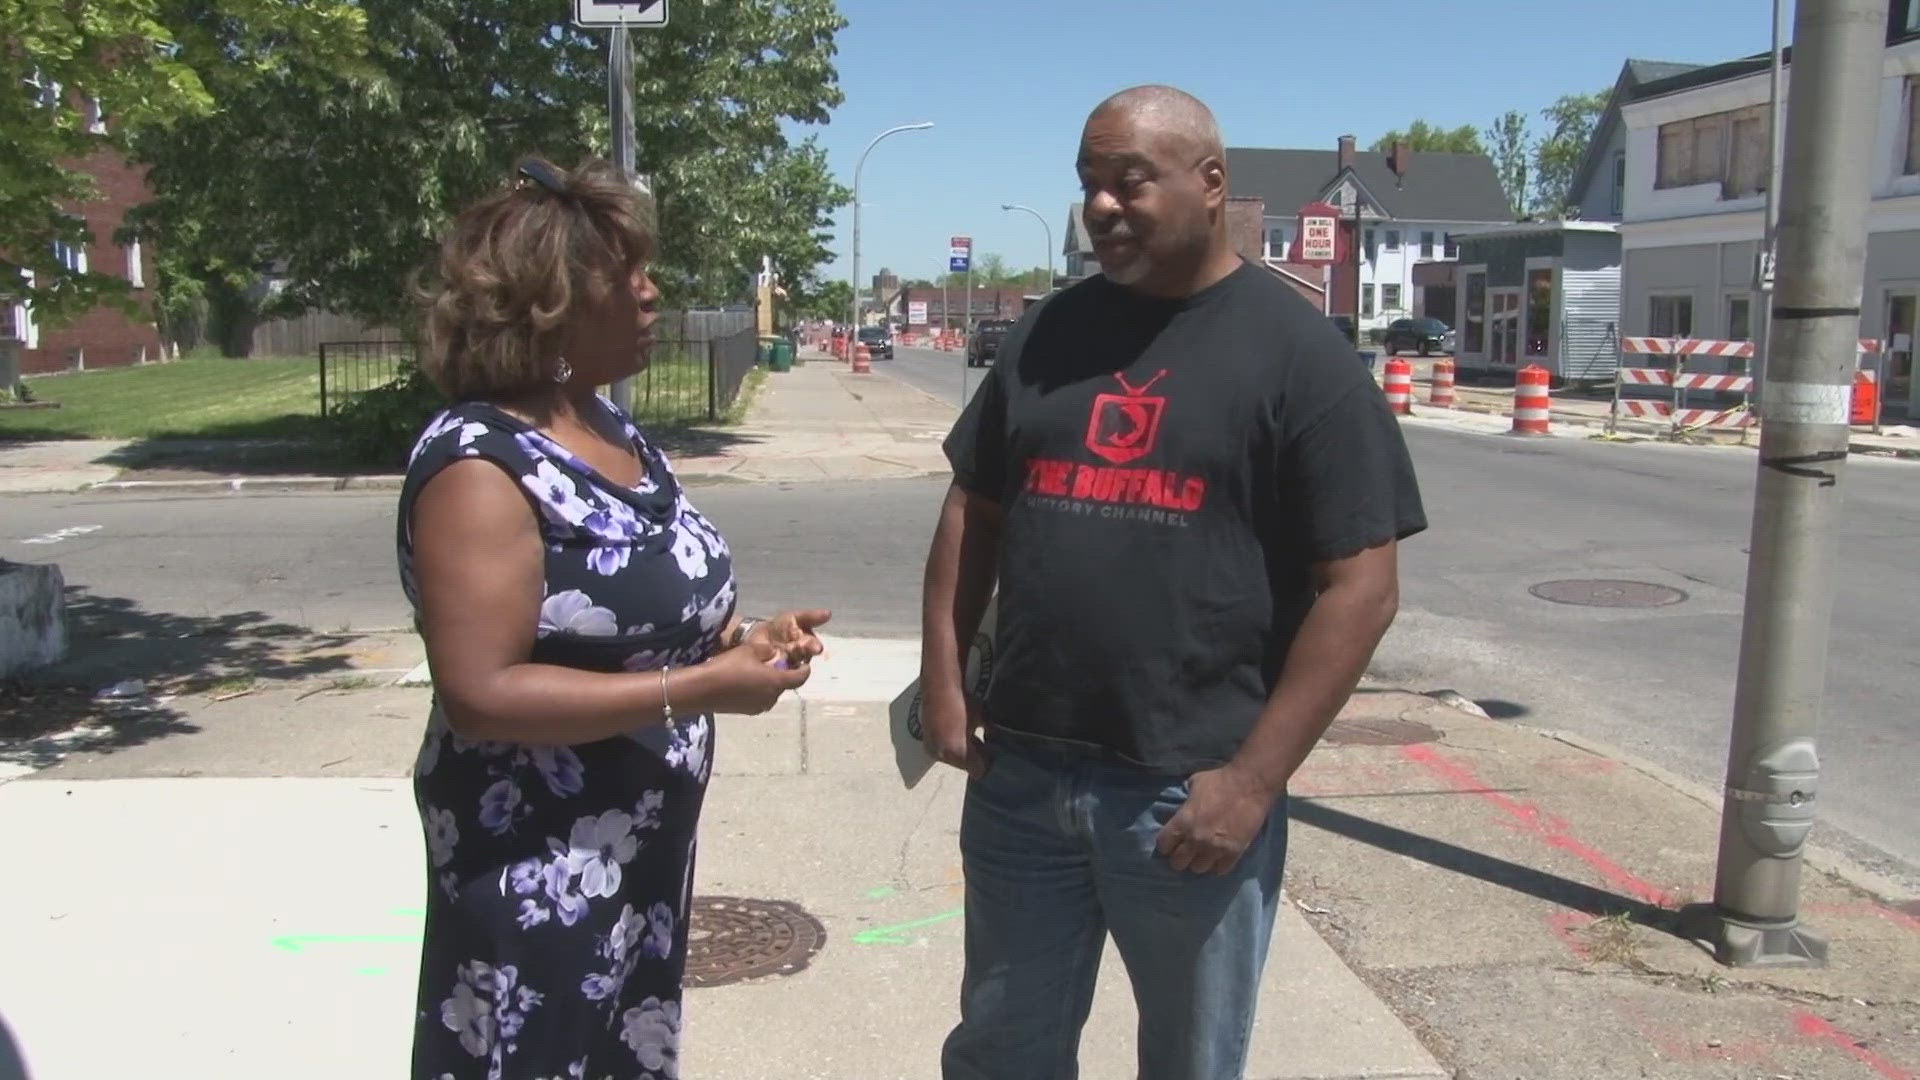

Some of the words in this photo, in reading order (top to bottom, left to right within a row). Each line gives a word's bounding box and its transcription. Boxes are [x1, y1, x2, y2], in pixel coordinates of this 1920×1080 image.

[1309, 227, 1329, 238] ONE
[1305, 239, 1331, 248] HOUR
[1071, 464, 1205, 512] BUFFALO
[1101, 506, 1189, 527] CHANNEL
